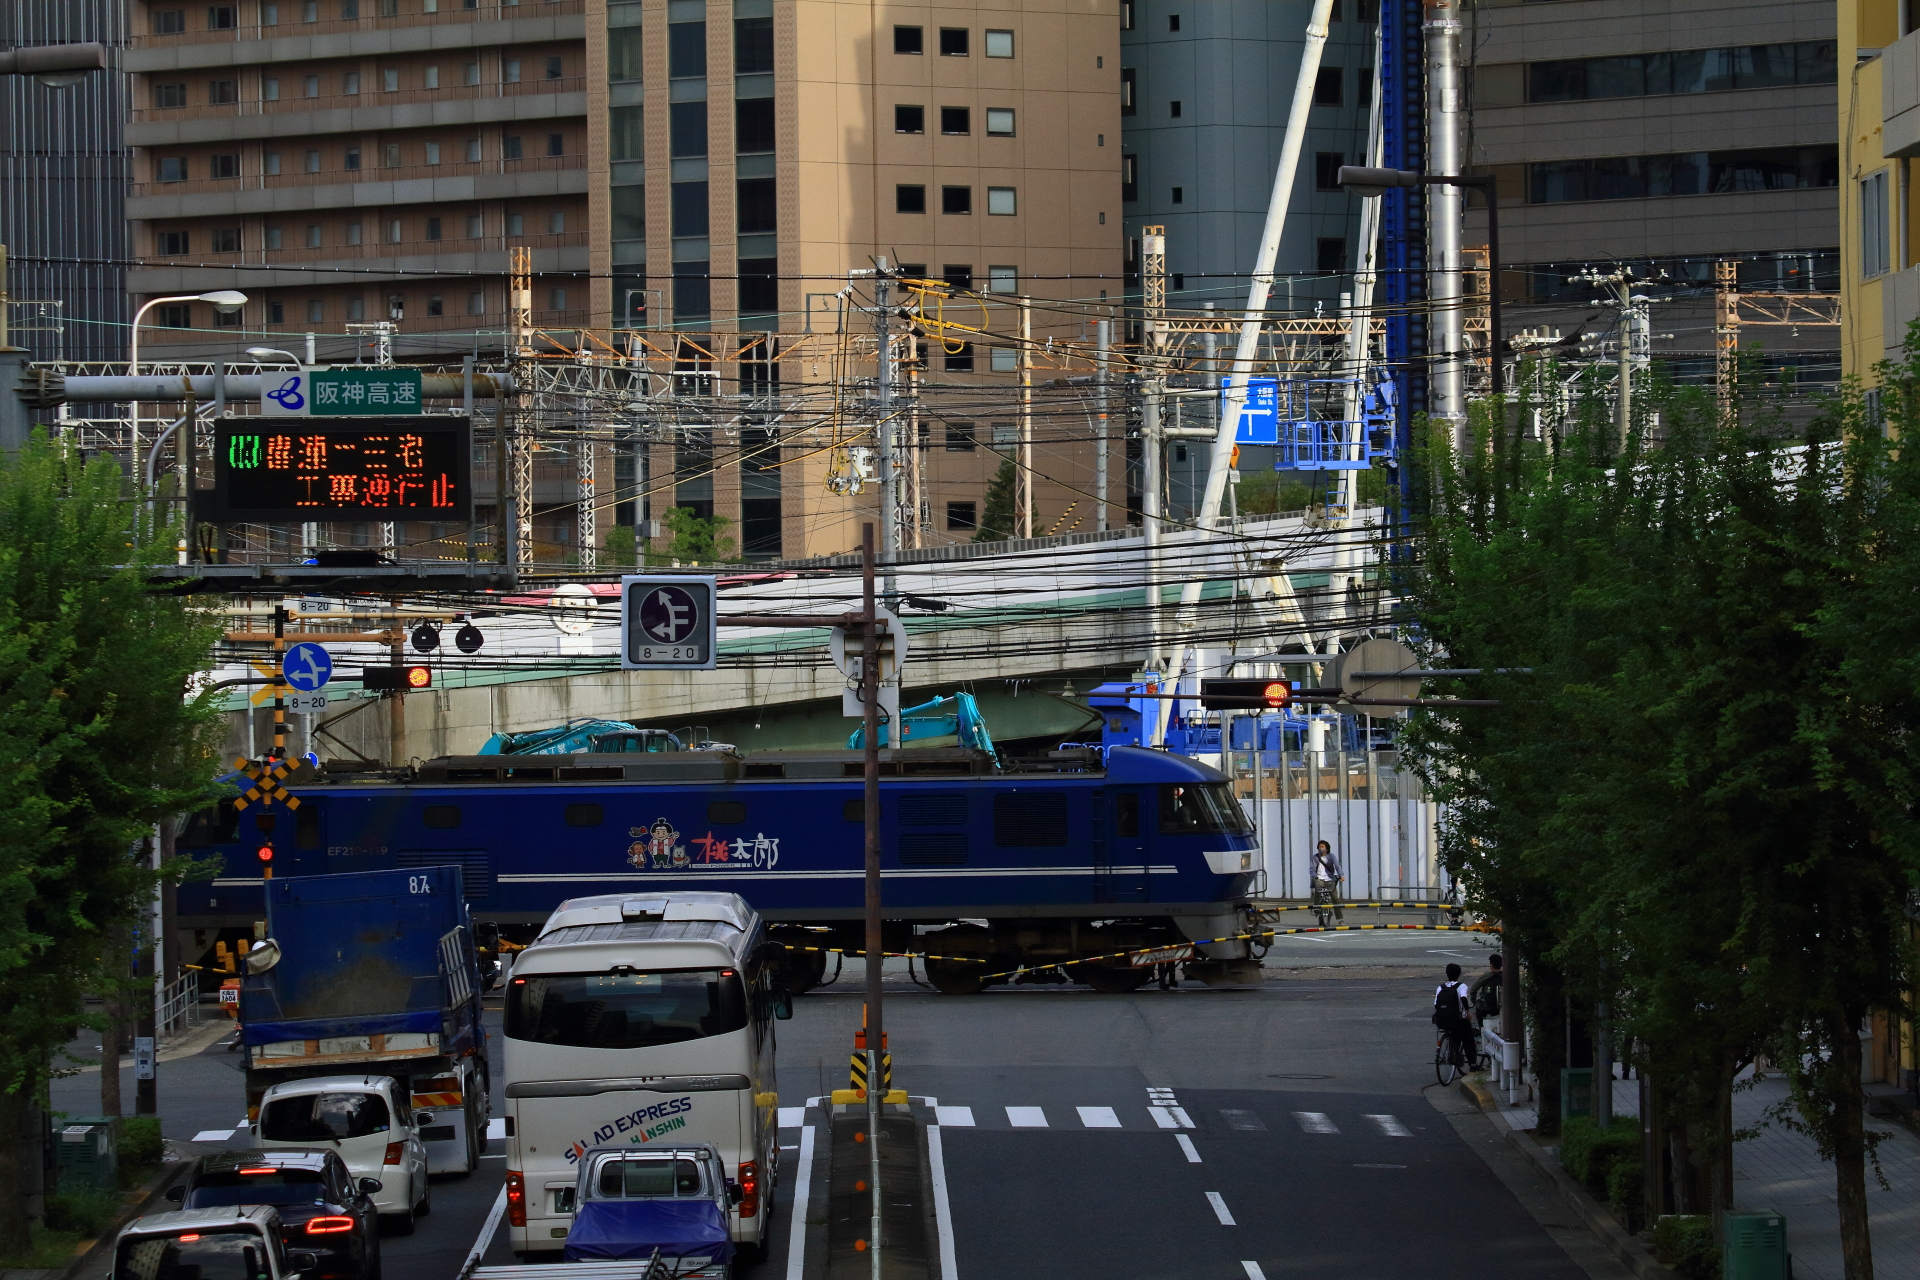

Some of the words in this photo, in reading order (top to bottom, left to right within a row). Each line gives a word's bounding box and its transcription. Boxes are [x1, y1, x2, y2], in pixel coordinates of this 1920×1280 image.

[316, 381, 416, 405] 阪神高速
[643, 647, 695, 659] 8-20
[292, 698, 326, 708] 8-20
[691, 831, 780, 870] 桃太郎
[615, 1096, 692, 1133] EXPRESS
